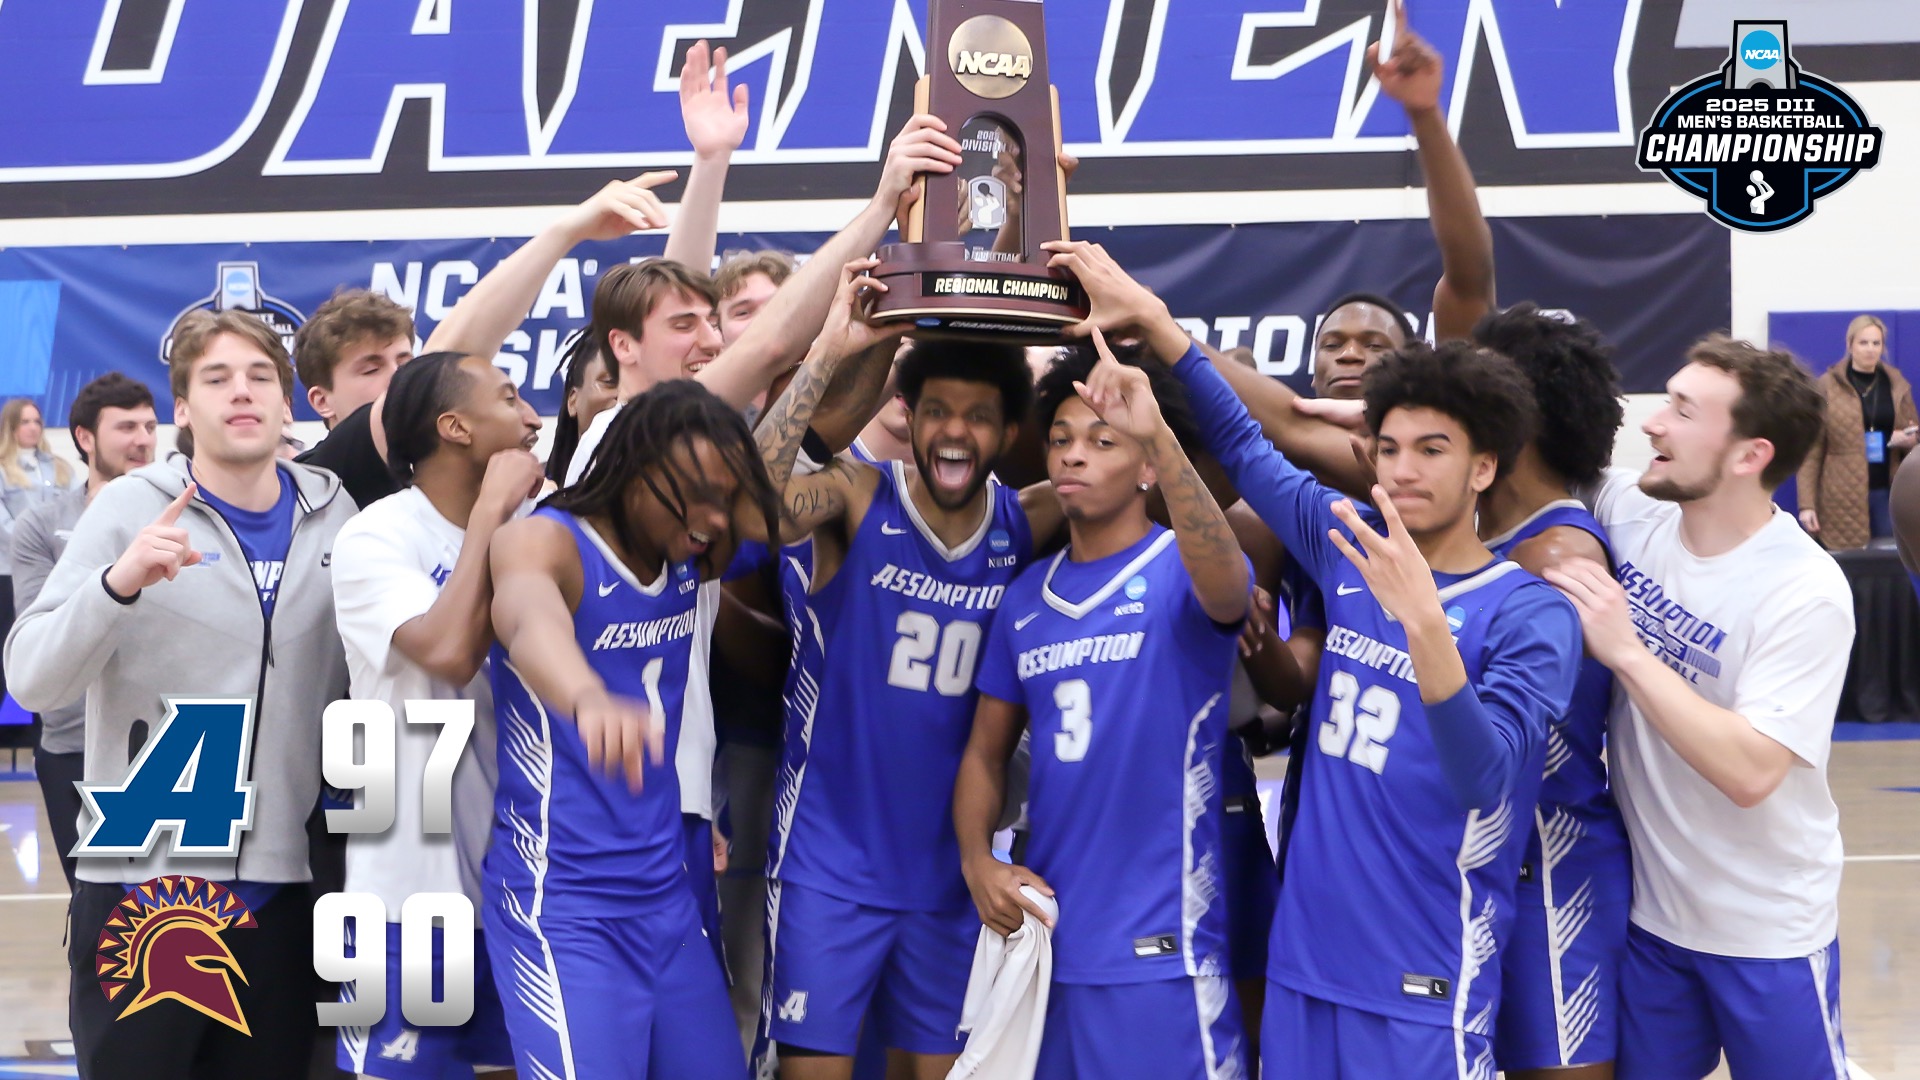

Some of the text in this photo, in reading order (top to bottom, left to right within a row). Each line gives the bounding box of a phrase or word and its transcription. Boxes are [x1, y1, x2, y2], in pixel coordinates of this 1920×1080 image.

[957, 50, 1031, 79] NCAA
[369, 259, 586, 321] NCA
[934, 277, 1069, 300] REGIONAL CHAMPION
[870, 563, 1005, 610] ASSUMPTIO
[592, 606, 696, 651] ASSUMPTION
[887, 610, 983, 697] 20
[1017, 631, 1145, 682] ASSUMPTION
[1325, 624, 1418, 685] ASSUMPTI
[1053, 678, 1093, 763] 3
[1318, 669, 1402, 776] 32
